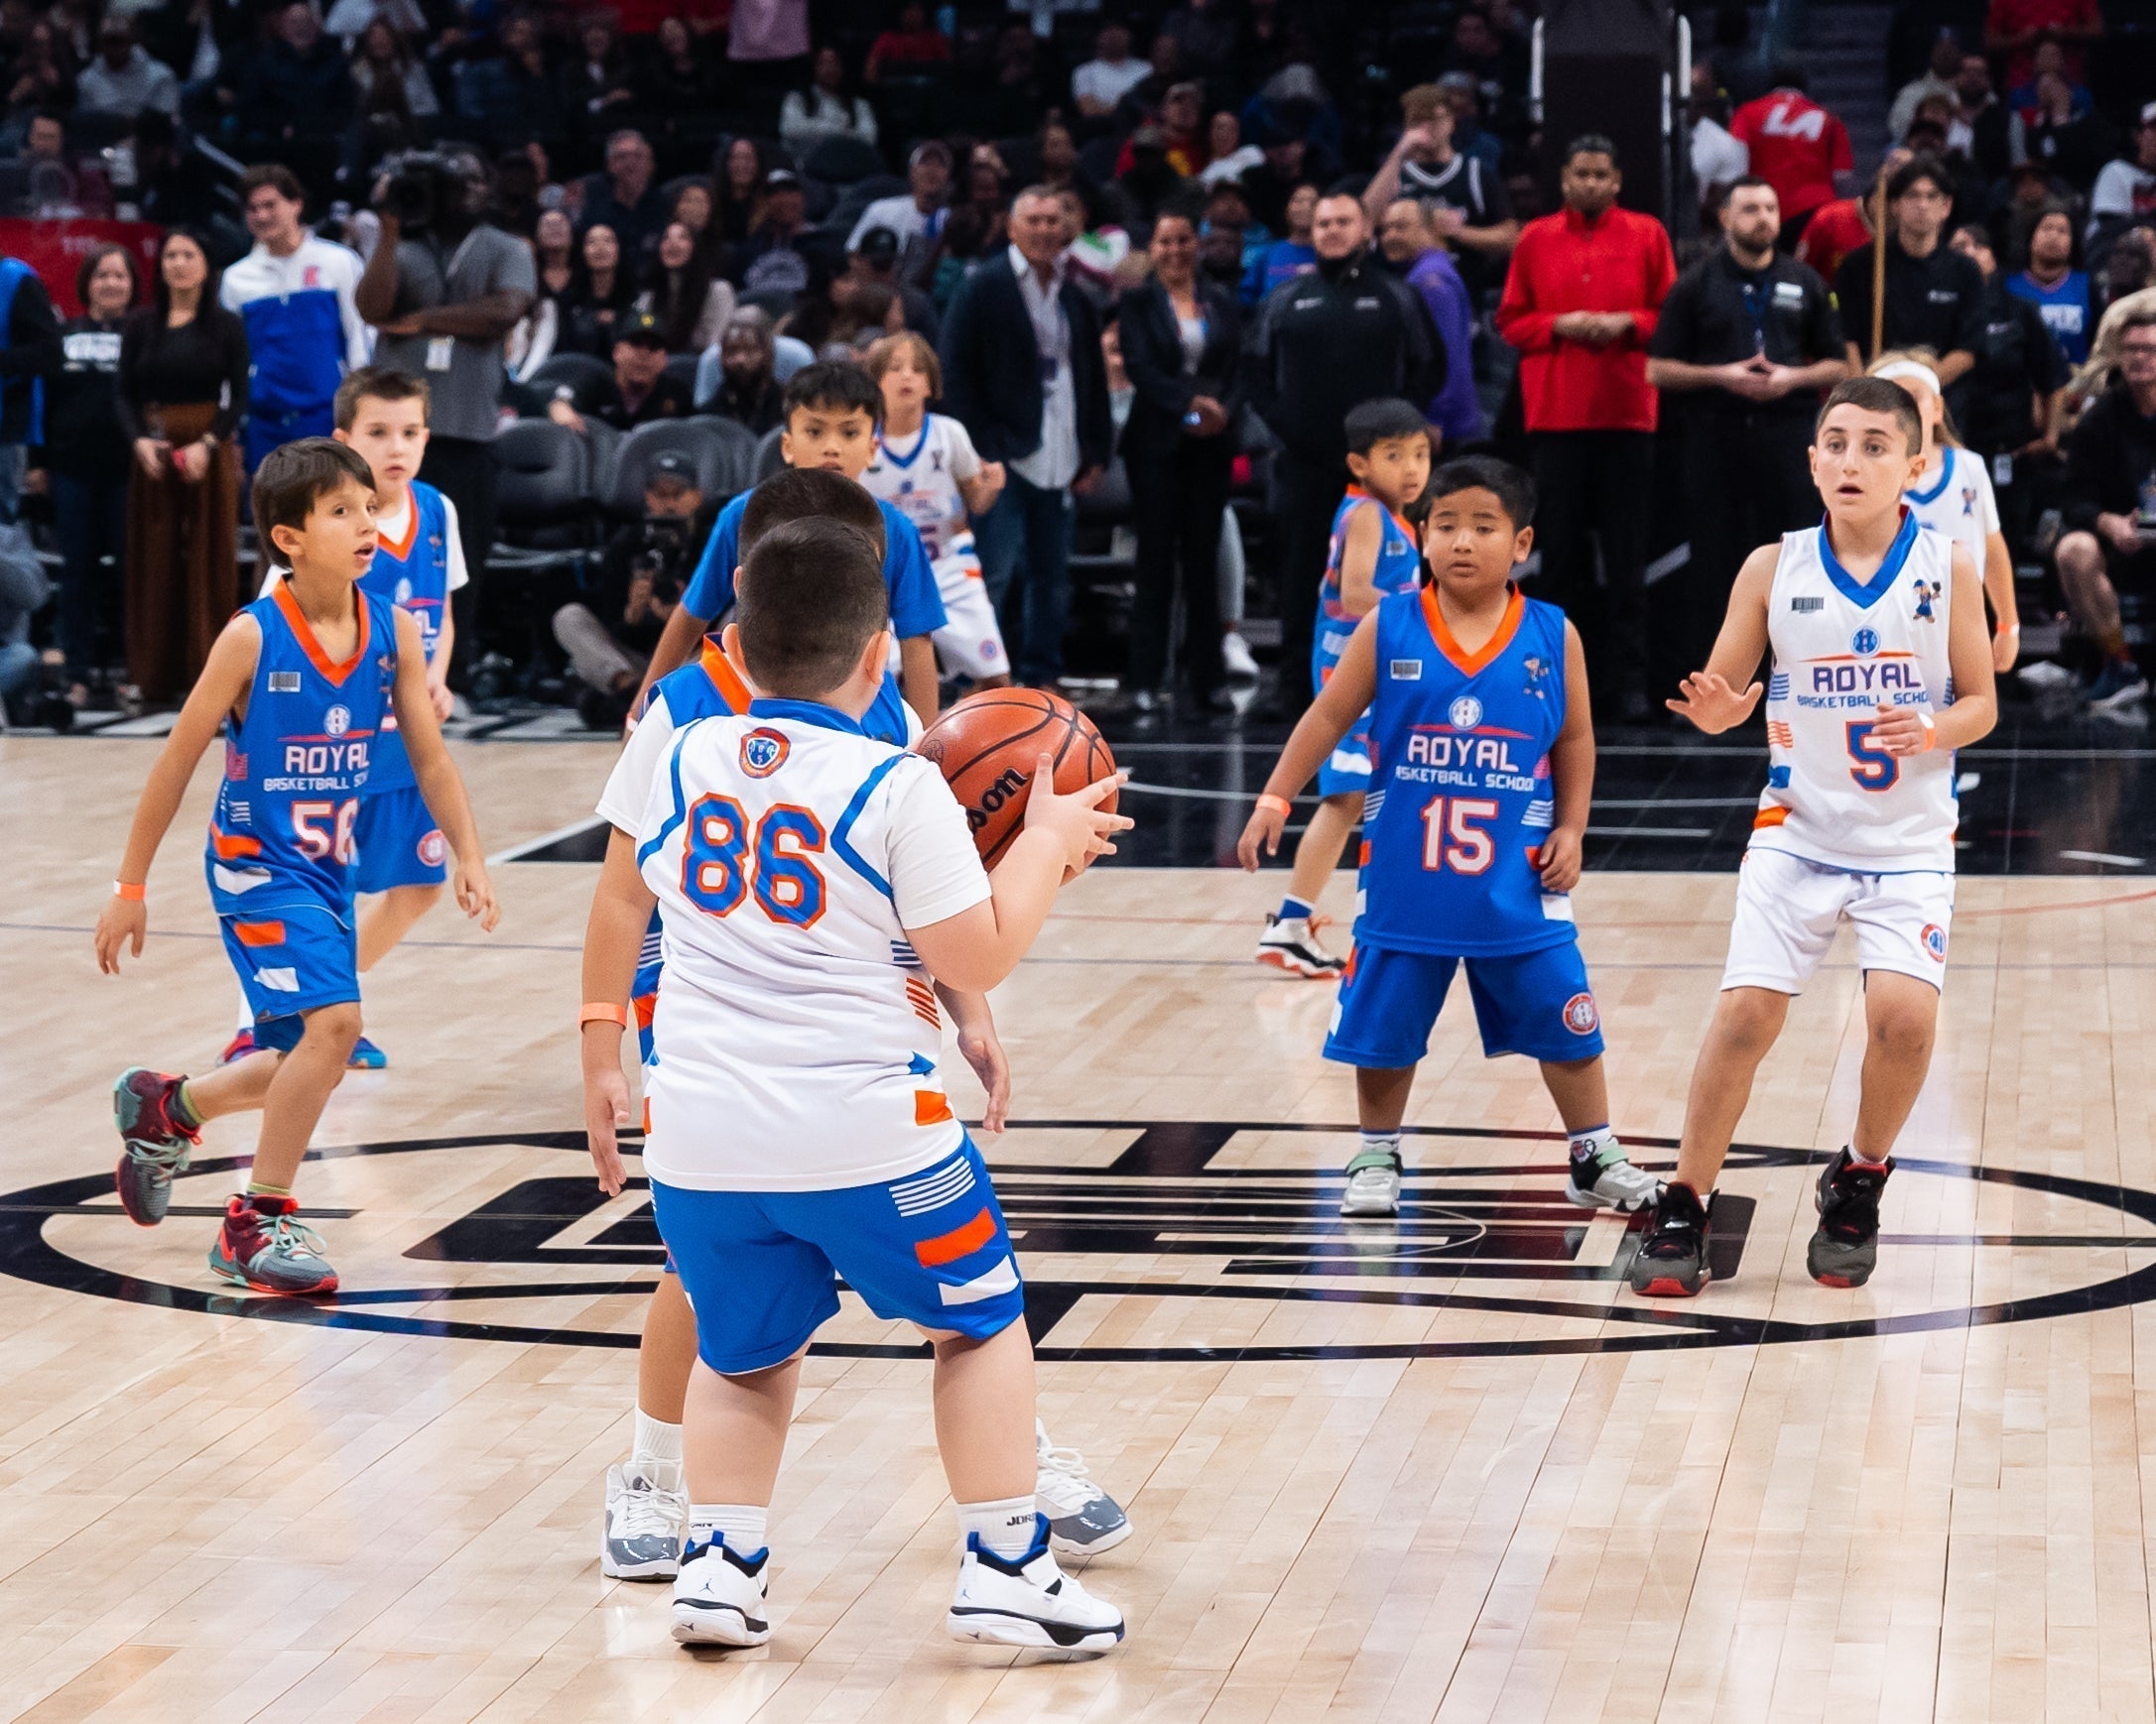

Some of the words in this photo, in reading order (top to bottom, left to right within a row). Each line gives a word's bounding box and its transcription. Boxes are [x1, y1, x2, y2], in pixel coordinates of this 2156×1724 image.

[1762, 103, 1825, 142] LA
[1813, 663, 1921, 692] ROYAL
[1893, 690, 1928, 704] SCHO
[285, 742, 370, 774] ROYAL
[1408, 734, 1519, 772] ROYAL
[1845, 720, 1900, 792] 5
[263, 775, 349, 792] BASKETBALL
[1395, 765, 1477, 788] ASKETBALL
[965, 767, 1029, 836] son
[1420, 795, 1499, 877] 15
[680, 792, 826, 930] 86
